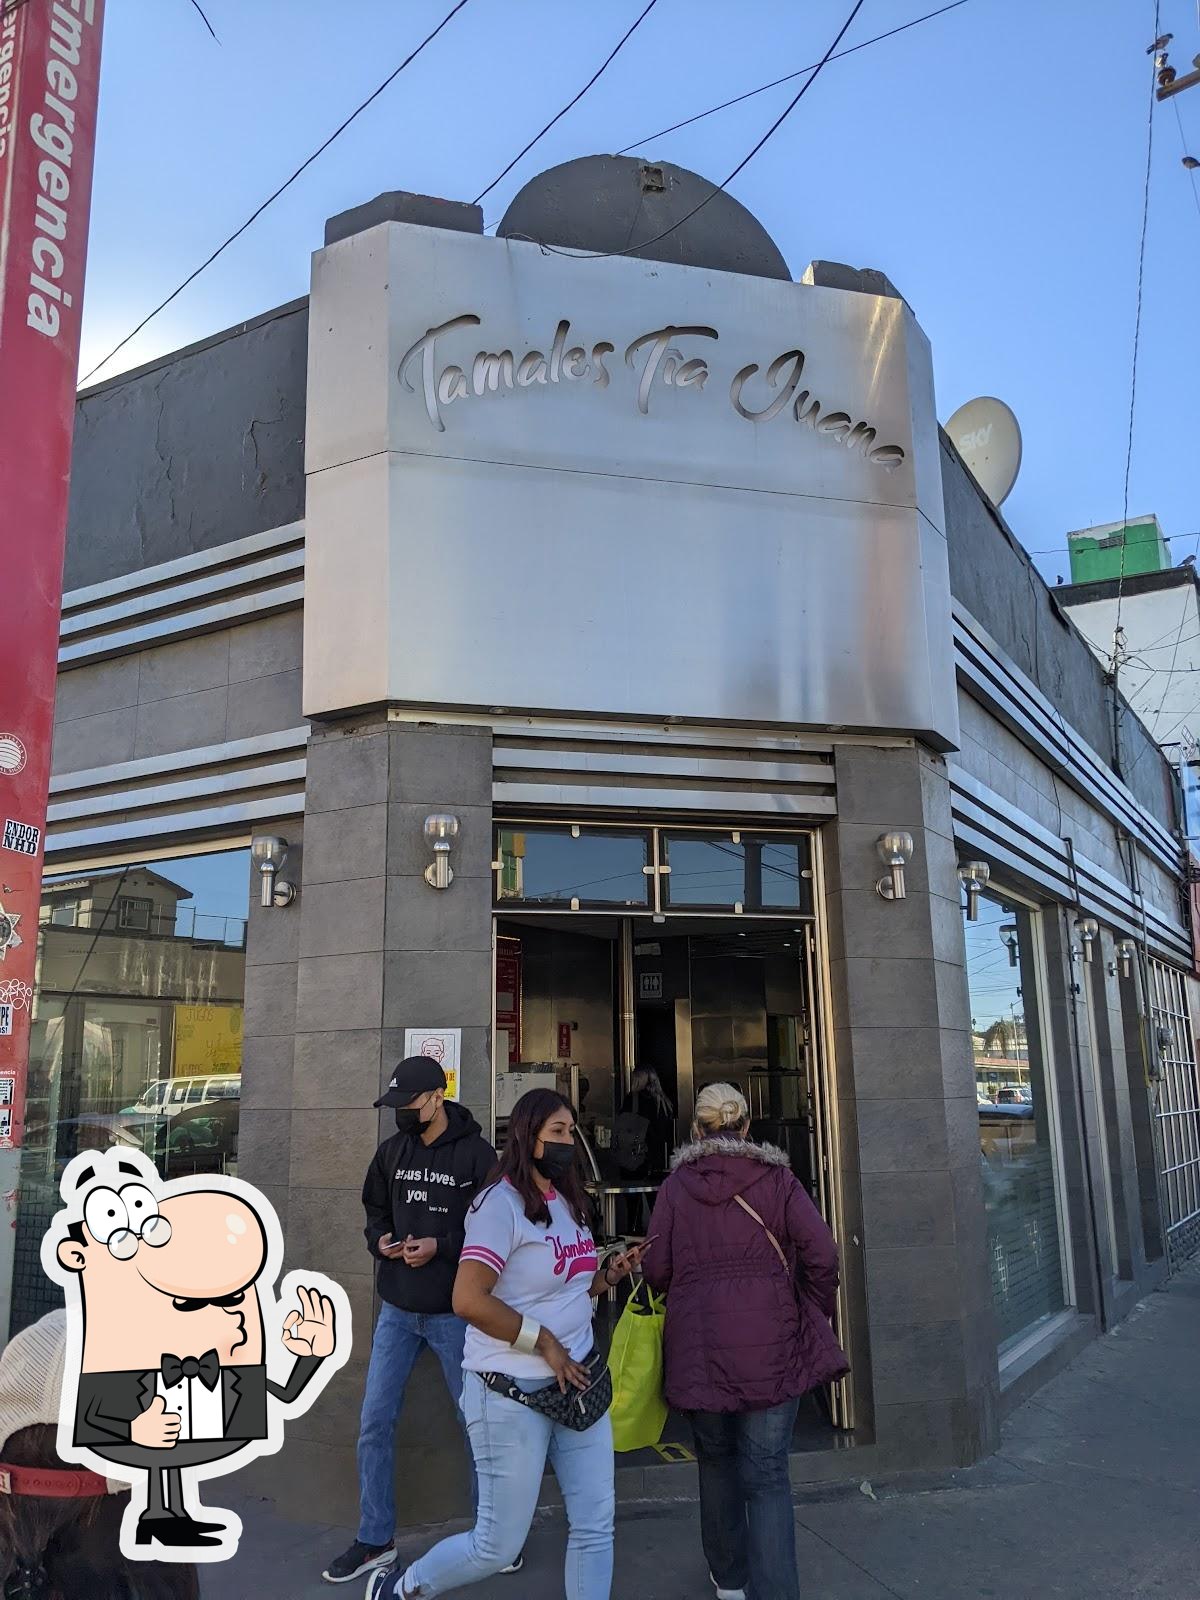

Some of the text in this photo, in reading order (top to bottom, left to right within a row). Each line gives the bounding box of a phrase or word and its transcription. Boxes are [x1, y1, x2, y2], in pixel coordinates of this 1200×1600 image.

[397, 314, 615, 432] Tamales
[730, 349, 904, 474] Juana
[959, 424, 992, 447] SKY
[5, 821, 39, 843] ENDOR
[3, 834, 37, 855] NHD
[424, 1168, 456, 1187] Loves
[405, 1189, 428, 1204] you
